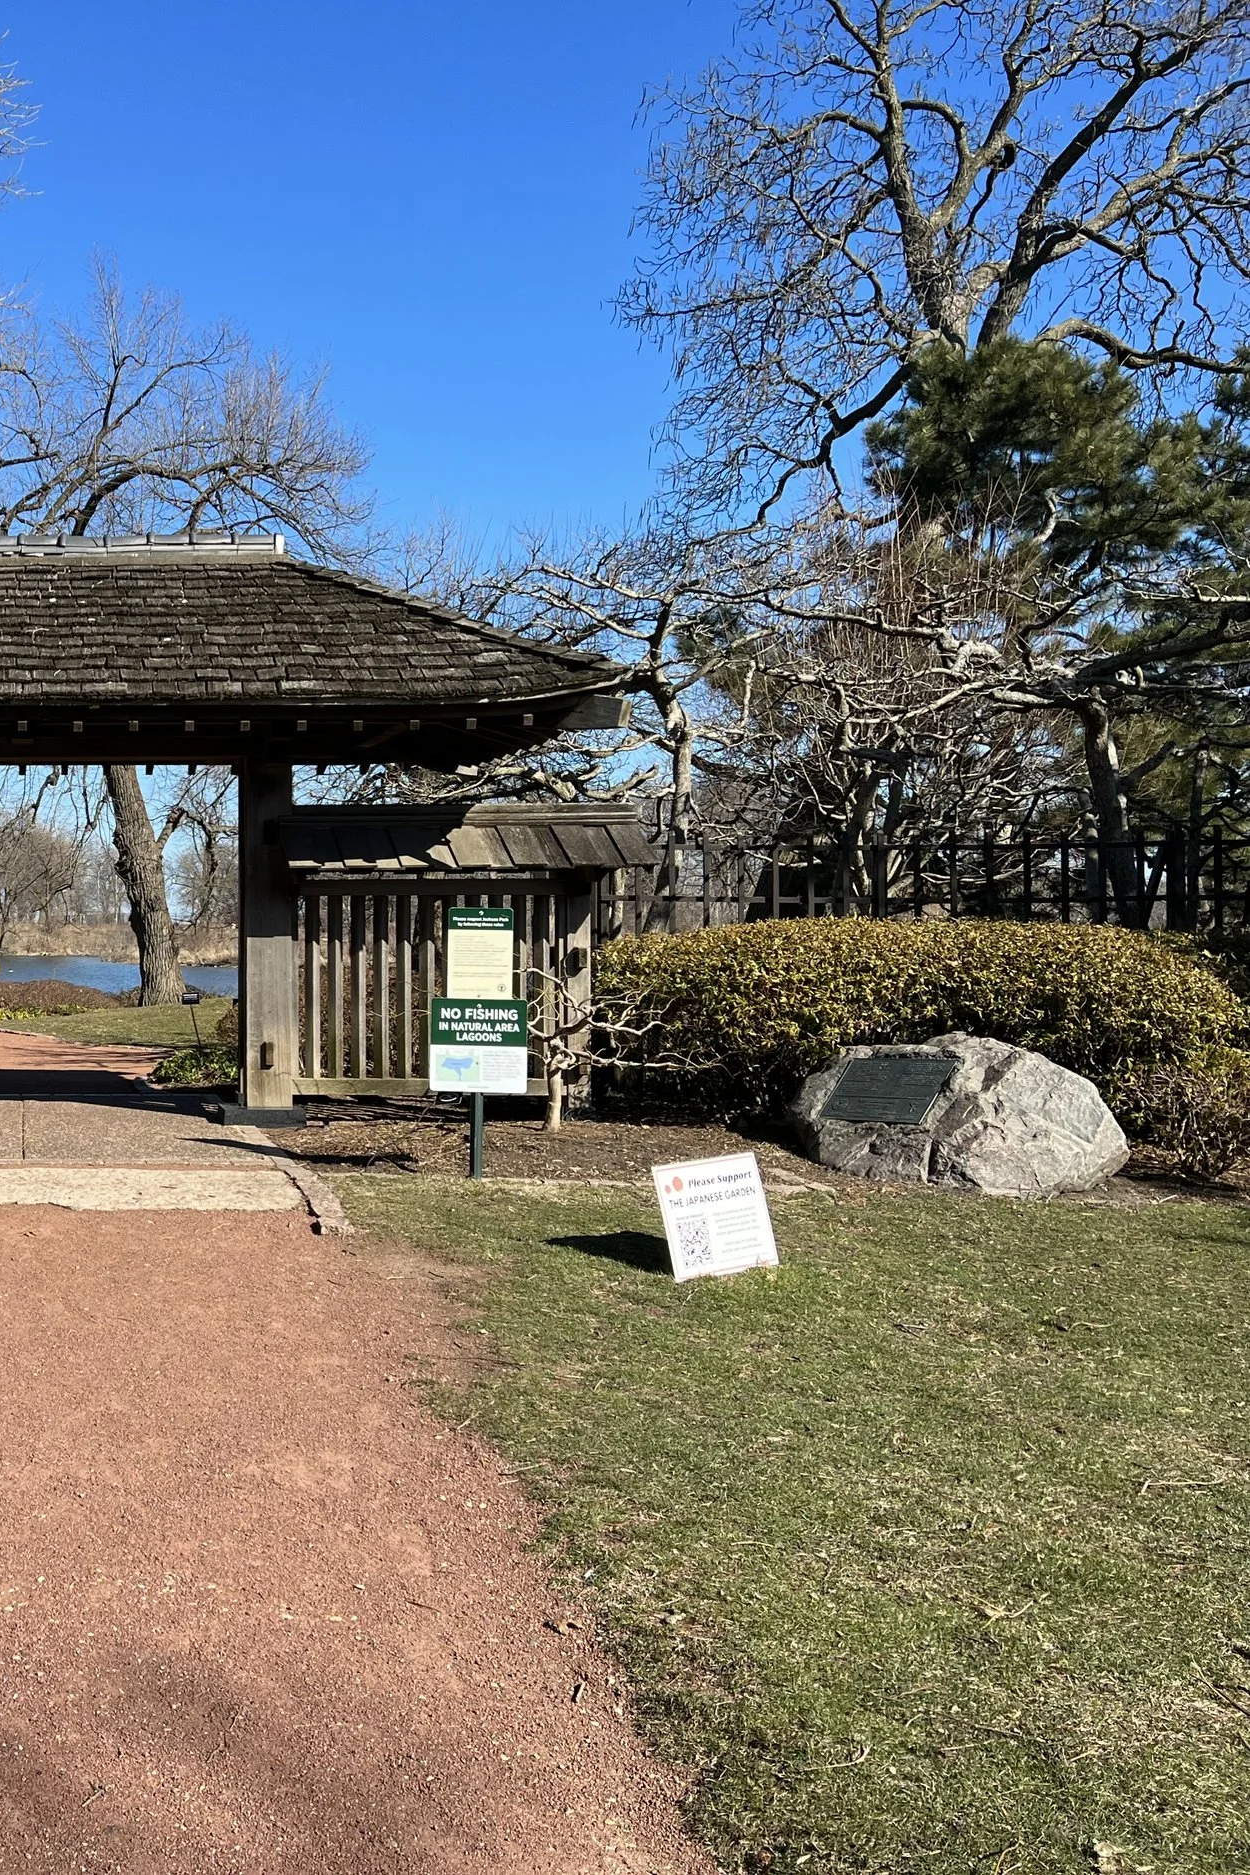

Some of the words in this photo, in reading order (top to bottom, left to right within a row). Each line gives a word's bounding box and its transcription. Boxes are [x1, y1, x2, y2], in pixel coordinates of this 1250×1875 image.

[440, 1007, 462, 1020] NO
[465, 1008, 519, 1021] FISHING
[438, 1021, 449, 1031] IN
[451, 1021, 493, 1032] NATURAL
[494, 1023, 520, 1032] AREA
[456, 1032, 502, 1042] LAGOONS
[688, 1178, 715, 1188] Please
[717, 1171, 752, 1184] Support
[669, 1198, 683, 1209] THE
[686, 1191, 723, 1207] JAPANESE
[724, 1186, 756, 1200] GARDEN
